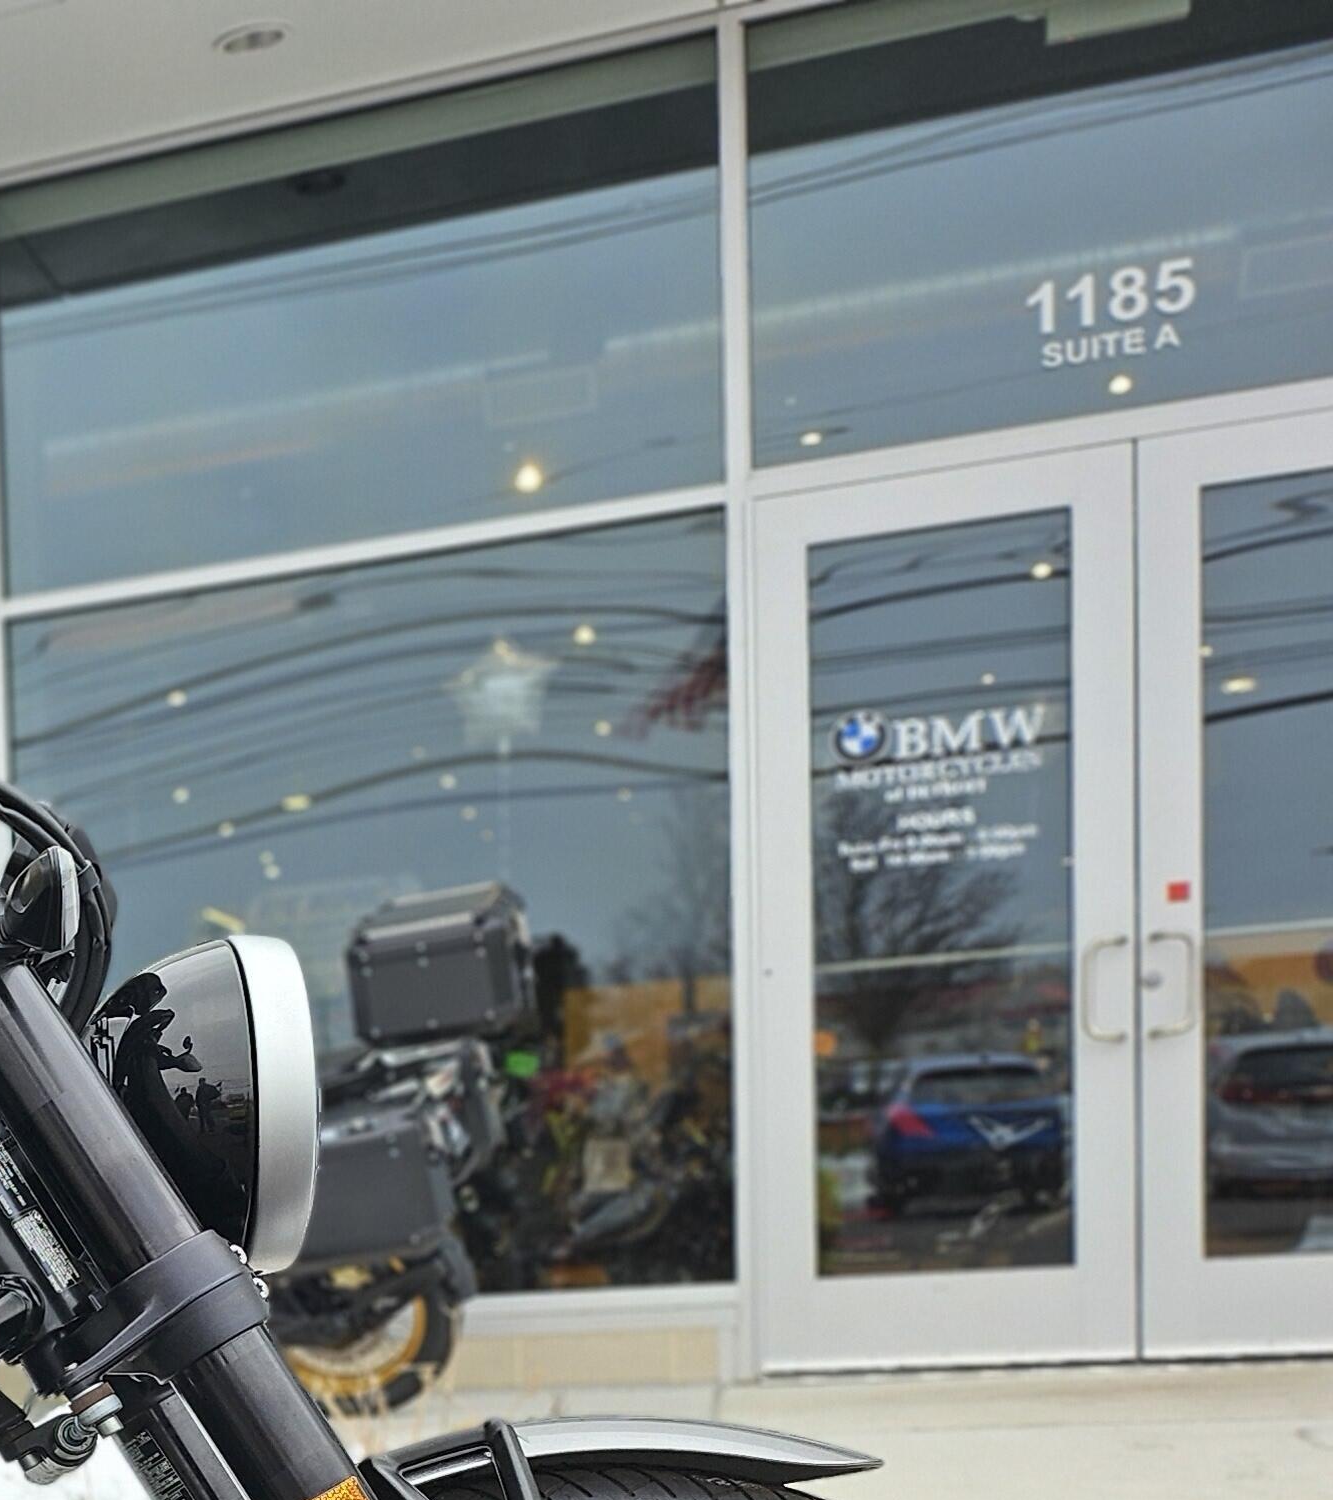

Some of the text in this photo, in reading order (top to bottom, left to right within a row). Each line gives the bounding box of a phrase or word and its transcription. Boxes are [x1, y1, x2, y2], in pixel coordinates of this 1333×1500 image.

[1026, 257, 1196, 334] 1185
[1042, 323, 1180, 368] SUITE A
[893, 704, 1045, 758] BMW
